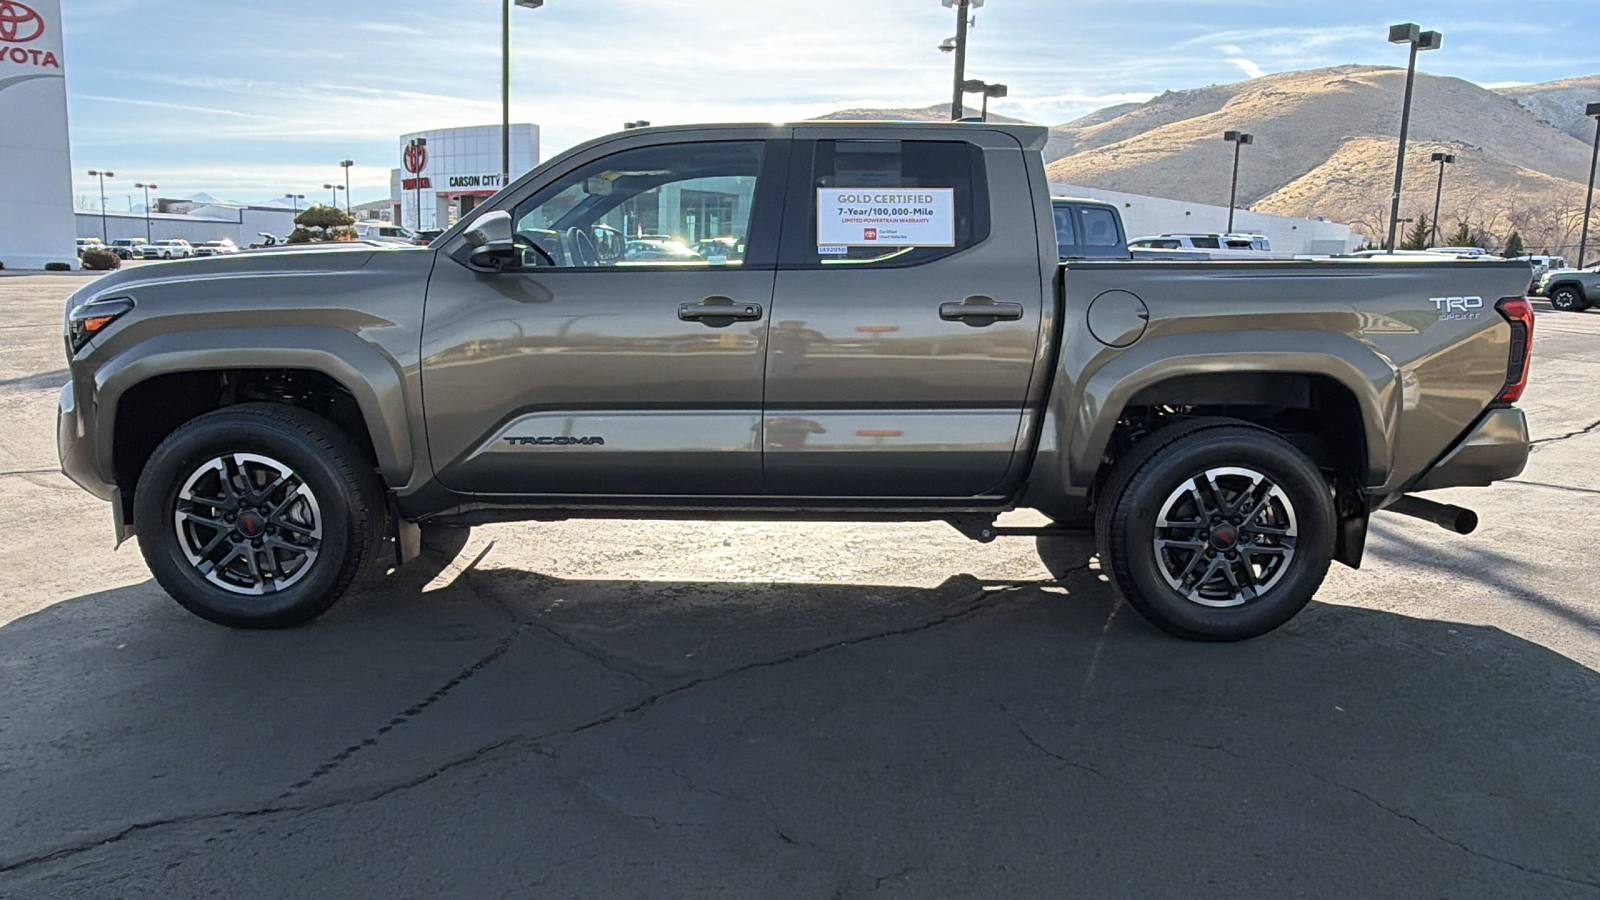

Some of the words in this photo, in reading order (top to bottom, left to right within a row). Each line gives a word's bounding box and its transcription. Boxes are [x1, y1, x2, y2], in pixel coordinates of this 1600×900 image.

[449, 175, 480, 187] CARSON
[482, 174, 501, 186] CITY
[837, 194, 872, 204] GOLD
[873, 194, 934, 204] CERTIFIED
[837, 207, 934, 217] 7-Year/100,000-Mile
[1428, 296, 1483, 313] TRD
[1437, 313, 1481, 321] SPORT
[503, 436, 605, 446] TACOMA
